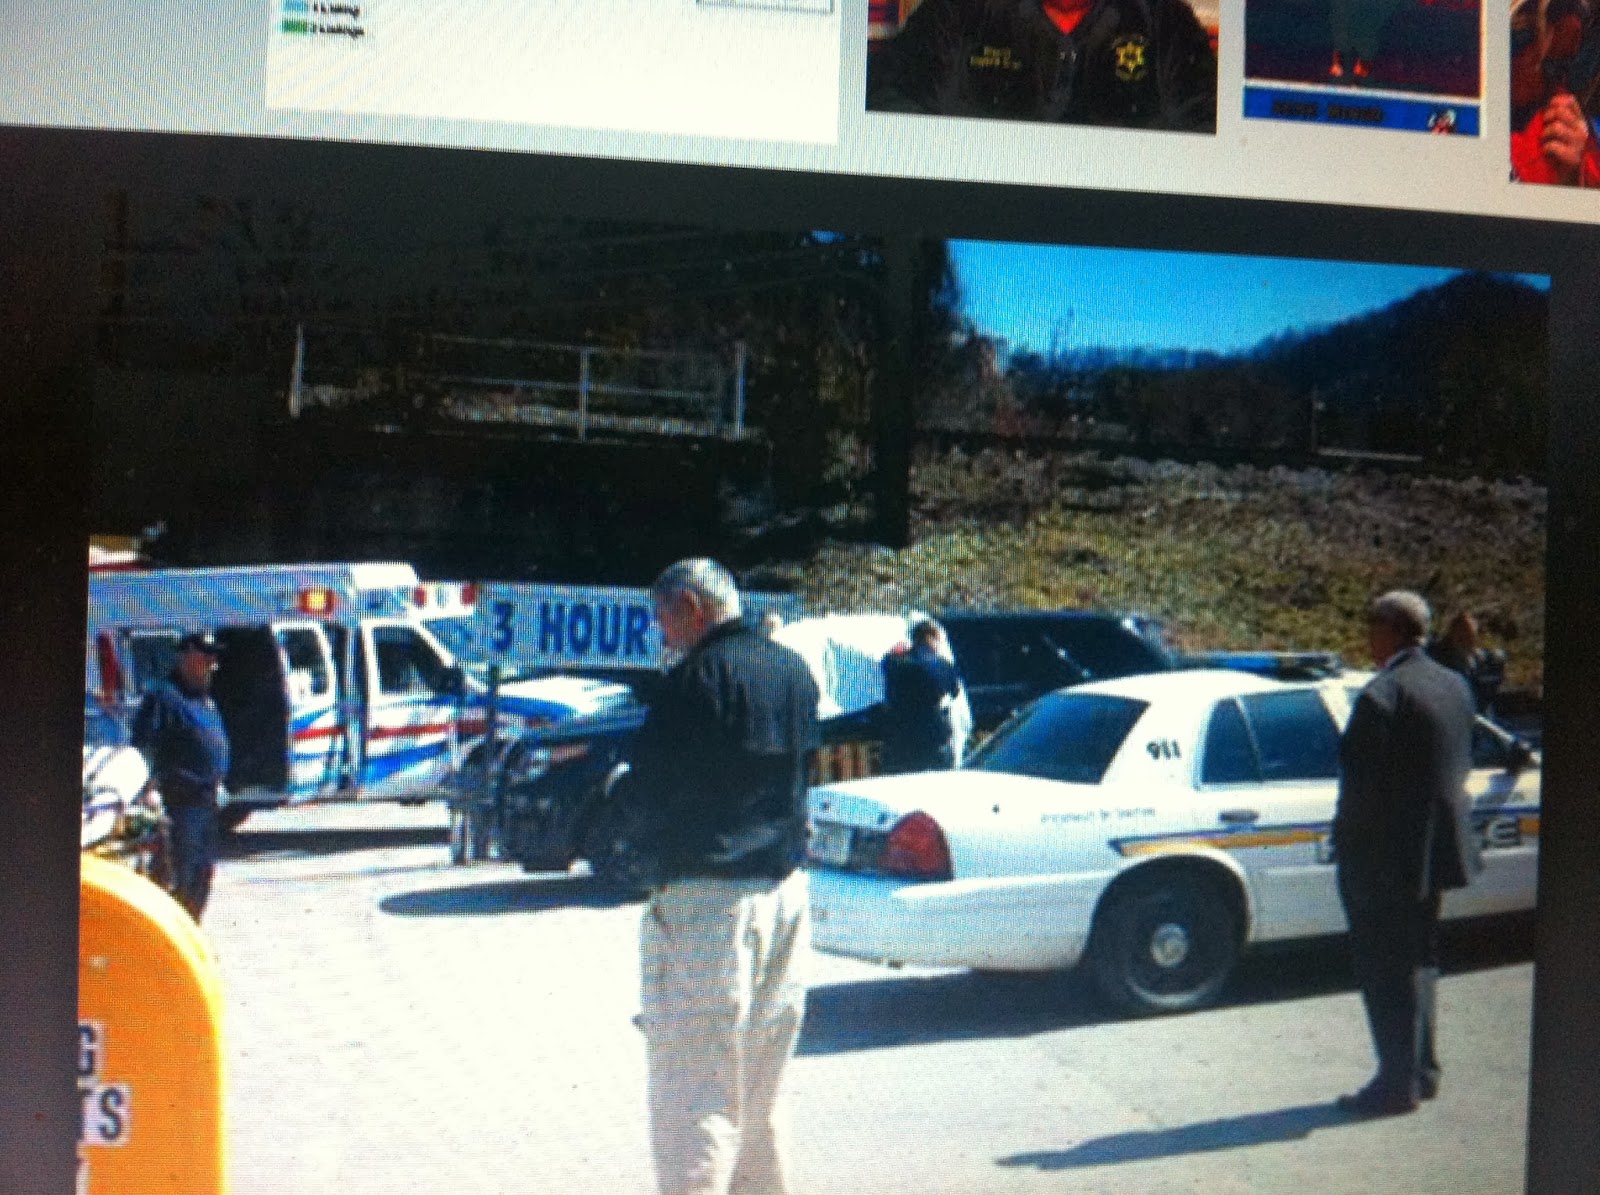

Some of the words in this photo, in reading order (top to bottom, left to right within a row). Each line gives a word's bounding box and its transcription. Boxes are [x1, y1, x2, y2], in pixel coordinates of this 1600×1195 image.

[493, 601, 513, 653] 3
[539, 602, 650, 656] HOUR
[1146, 738, 1182, 761] 911
